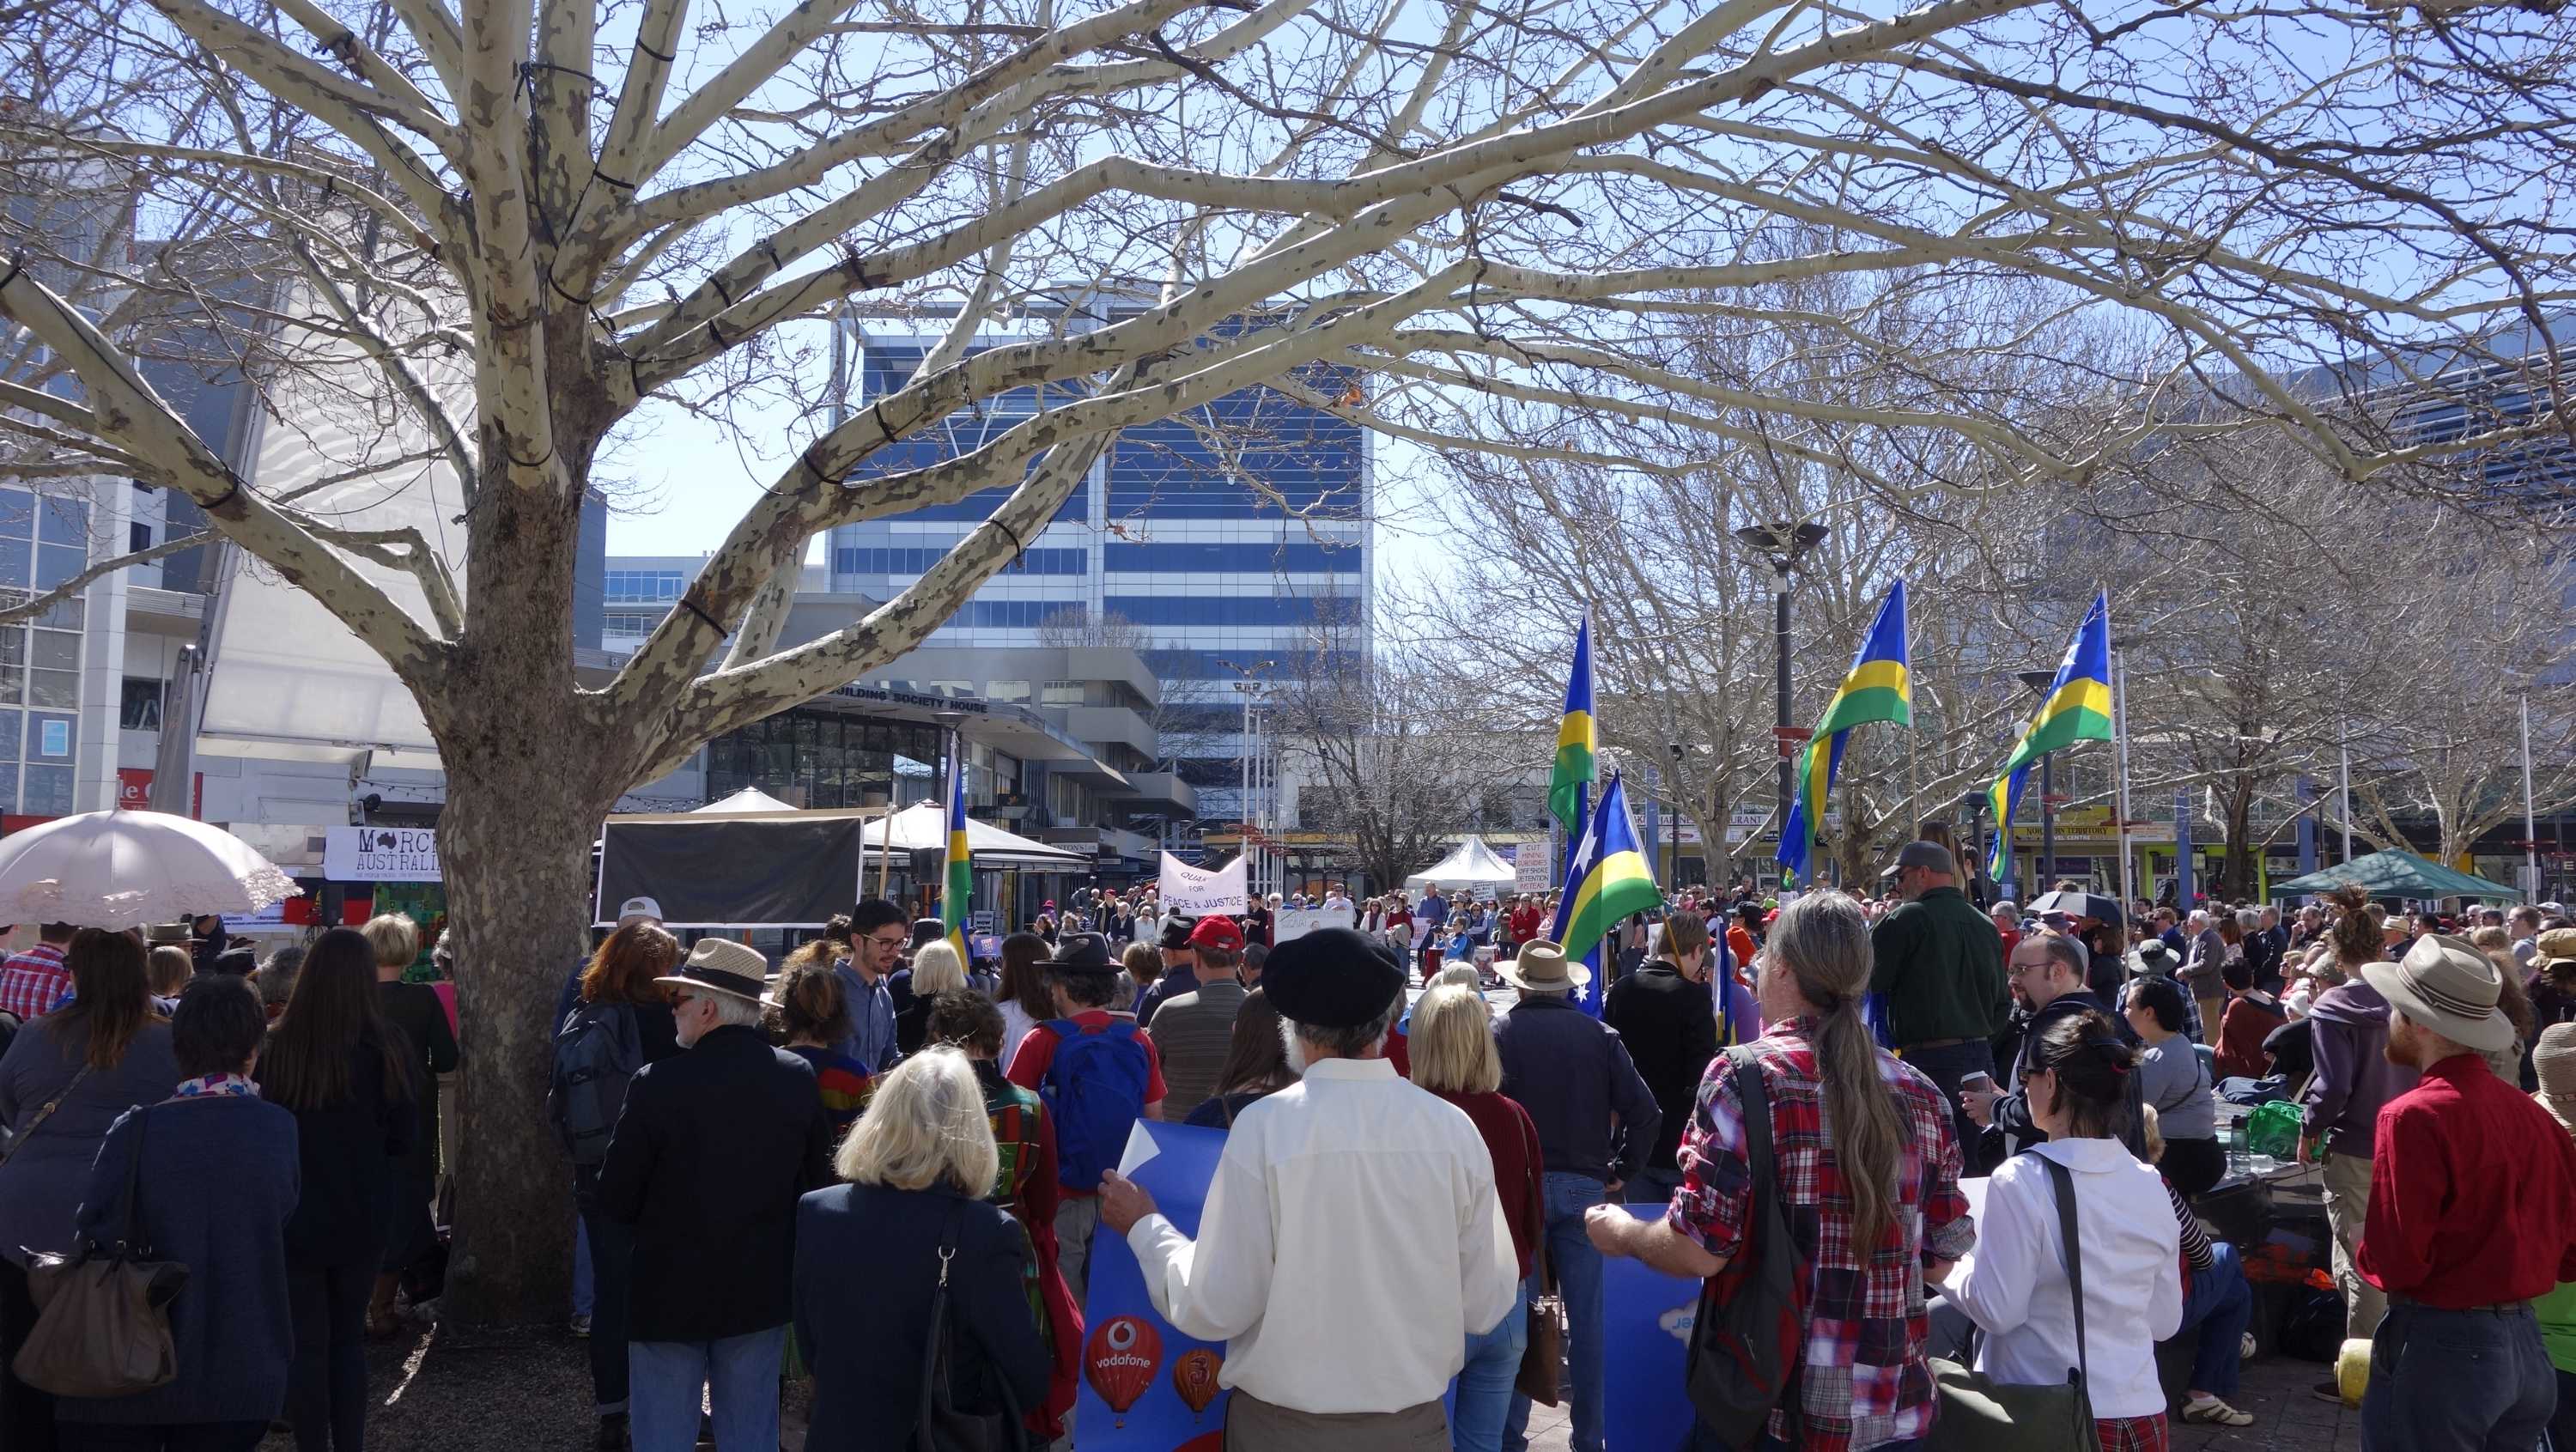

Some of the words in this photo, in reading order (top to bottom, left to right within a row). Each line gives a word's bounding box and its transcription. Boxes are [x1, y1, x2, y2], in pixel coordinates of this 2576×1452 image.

[893, 693, 945, 708] SOCIETY
[950, 700, 988, 714] HOUSE
[1729, 816, 1762, 824] URANT
[2067, 827, 2109, 835] TERRITORY
[357, 854, 440, 871] AUSTRALI
[1163, 894, 1192, 908] PEACE
[1204, 896, 1242, 908] JUSTICE
[1096, 1353, 1151, 1369] vodafone
